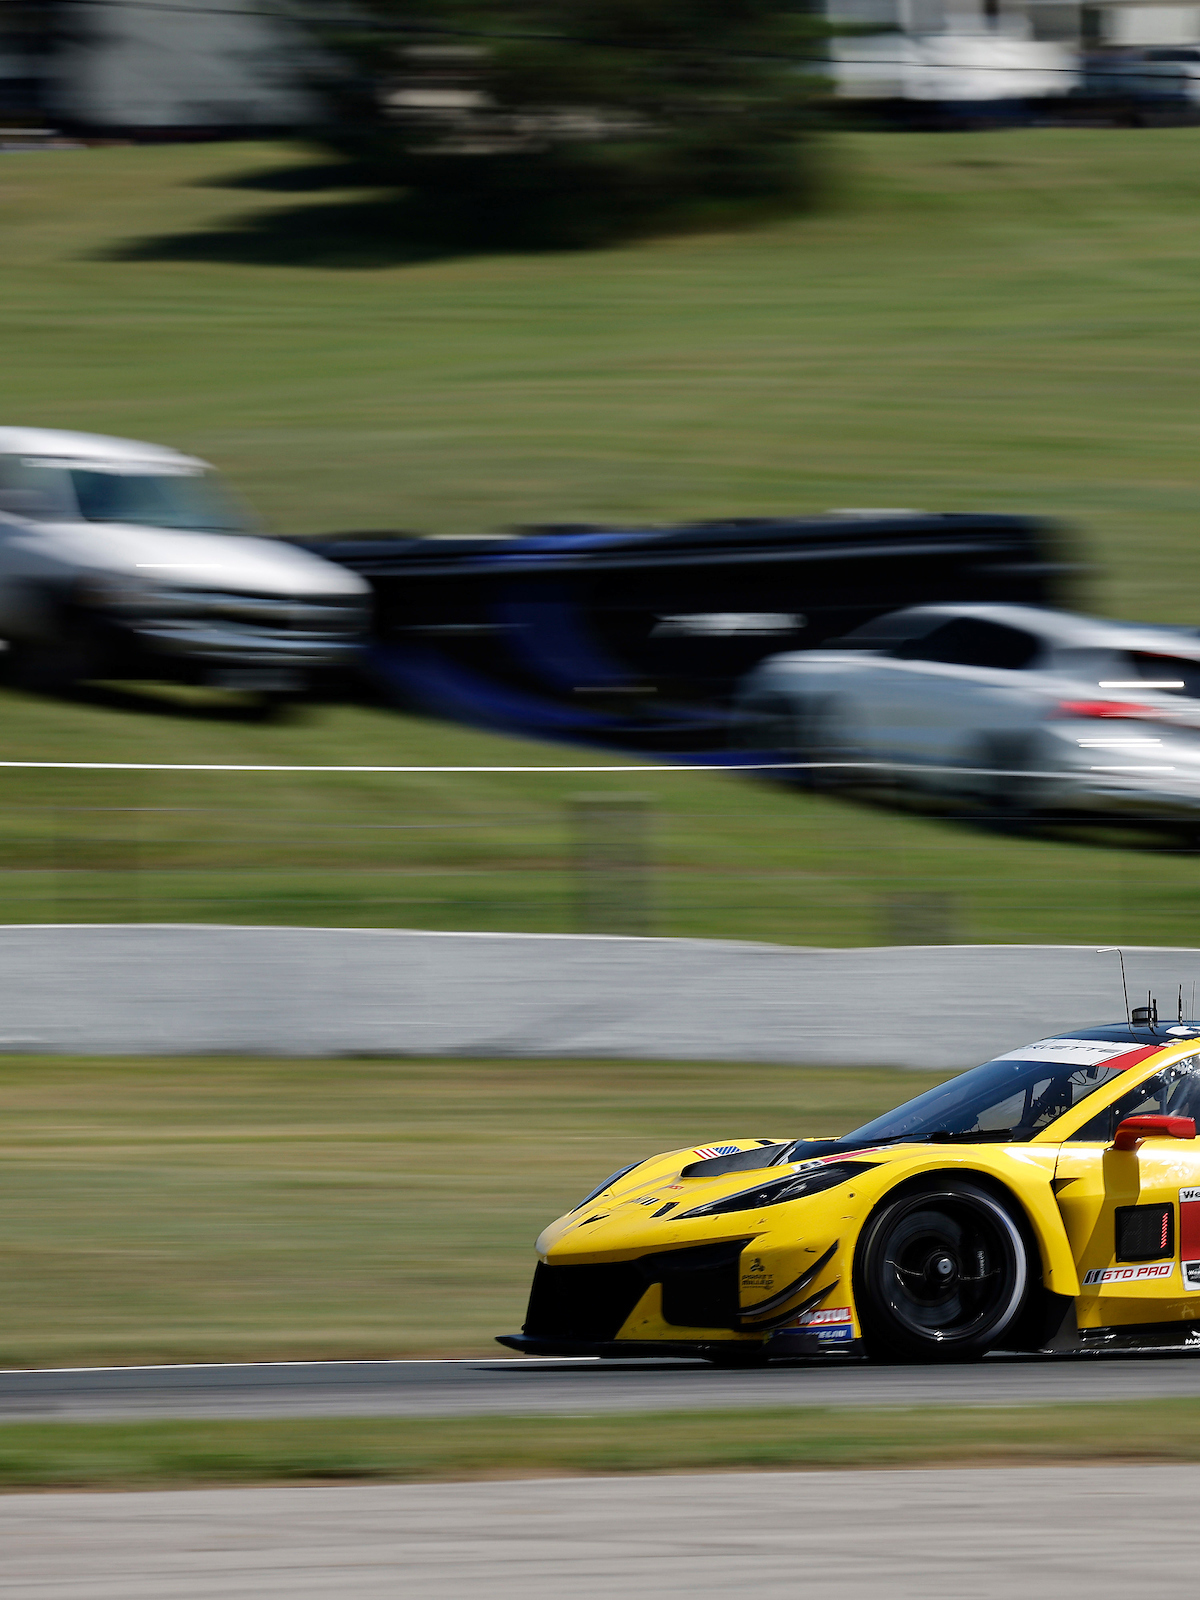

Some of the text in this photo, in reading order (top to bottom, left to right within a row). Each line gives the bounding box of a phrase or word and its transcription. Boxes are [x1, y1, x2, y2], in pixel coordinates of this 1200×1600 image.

[1101, 1265, 1171, 1280] GTD PRO
[799, 1308, 851, 1325] MOTUL
